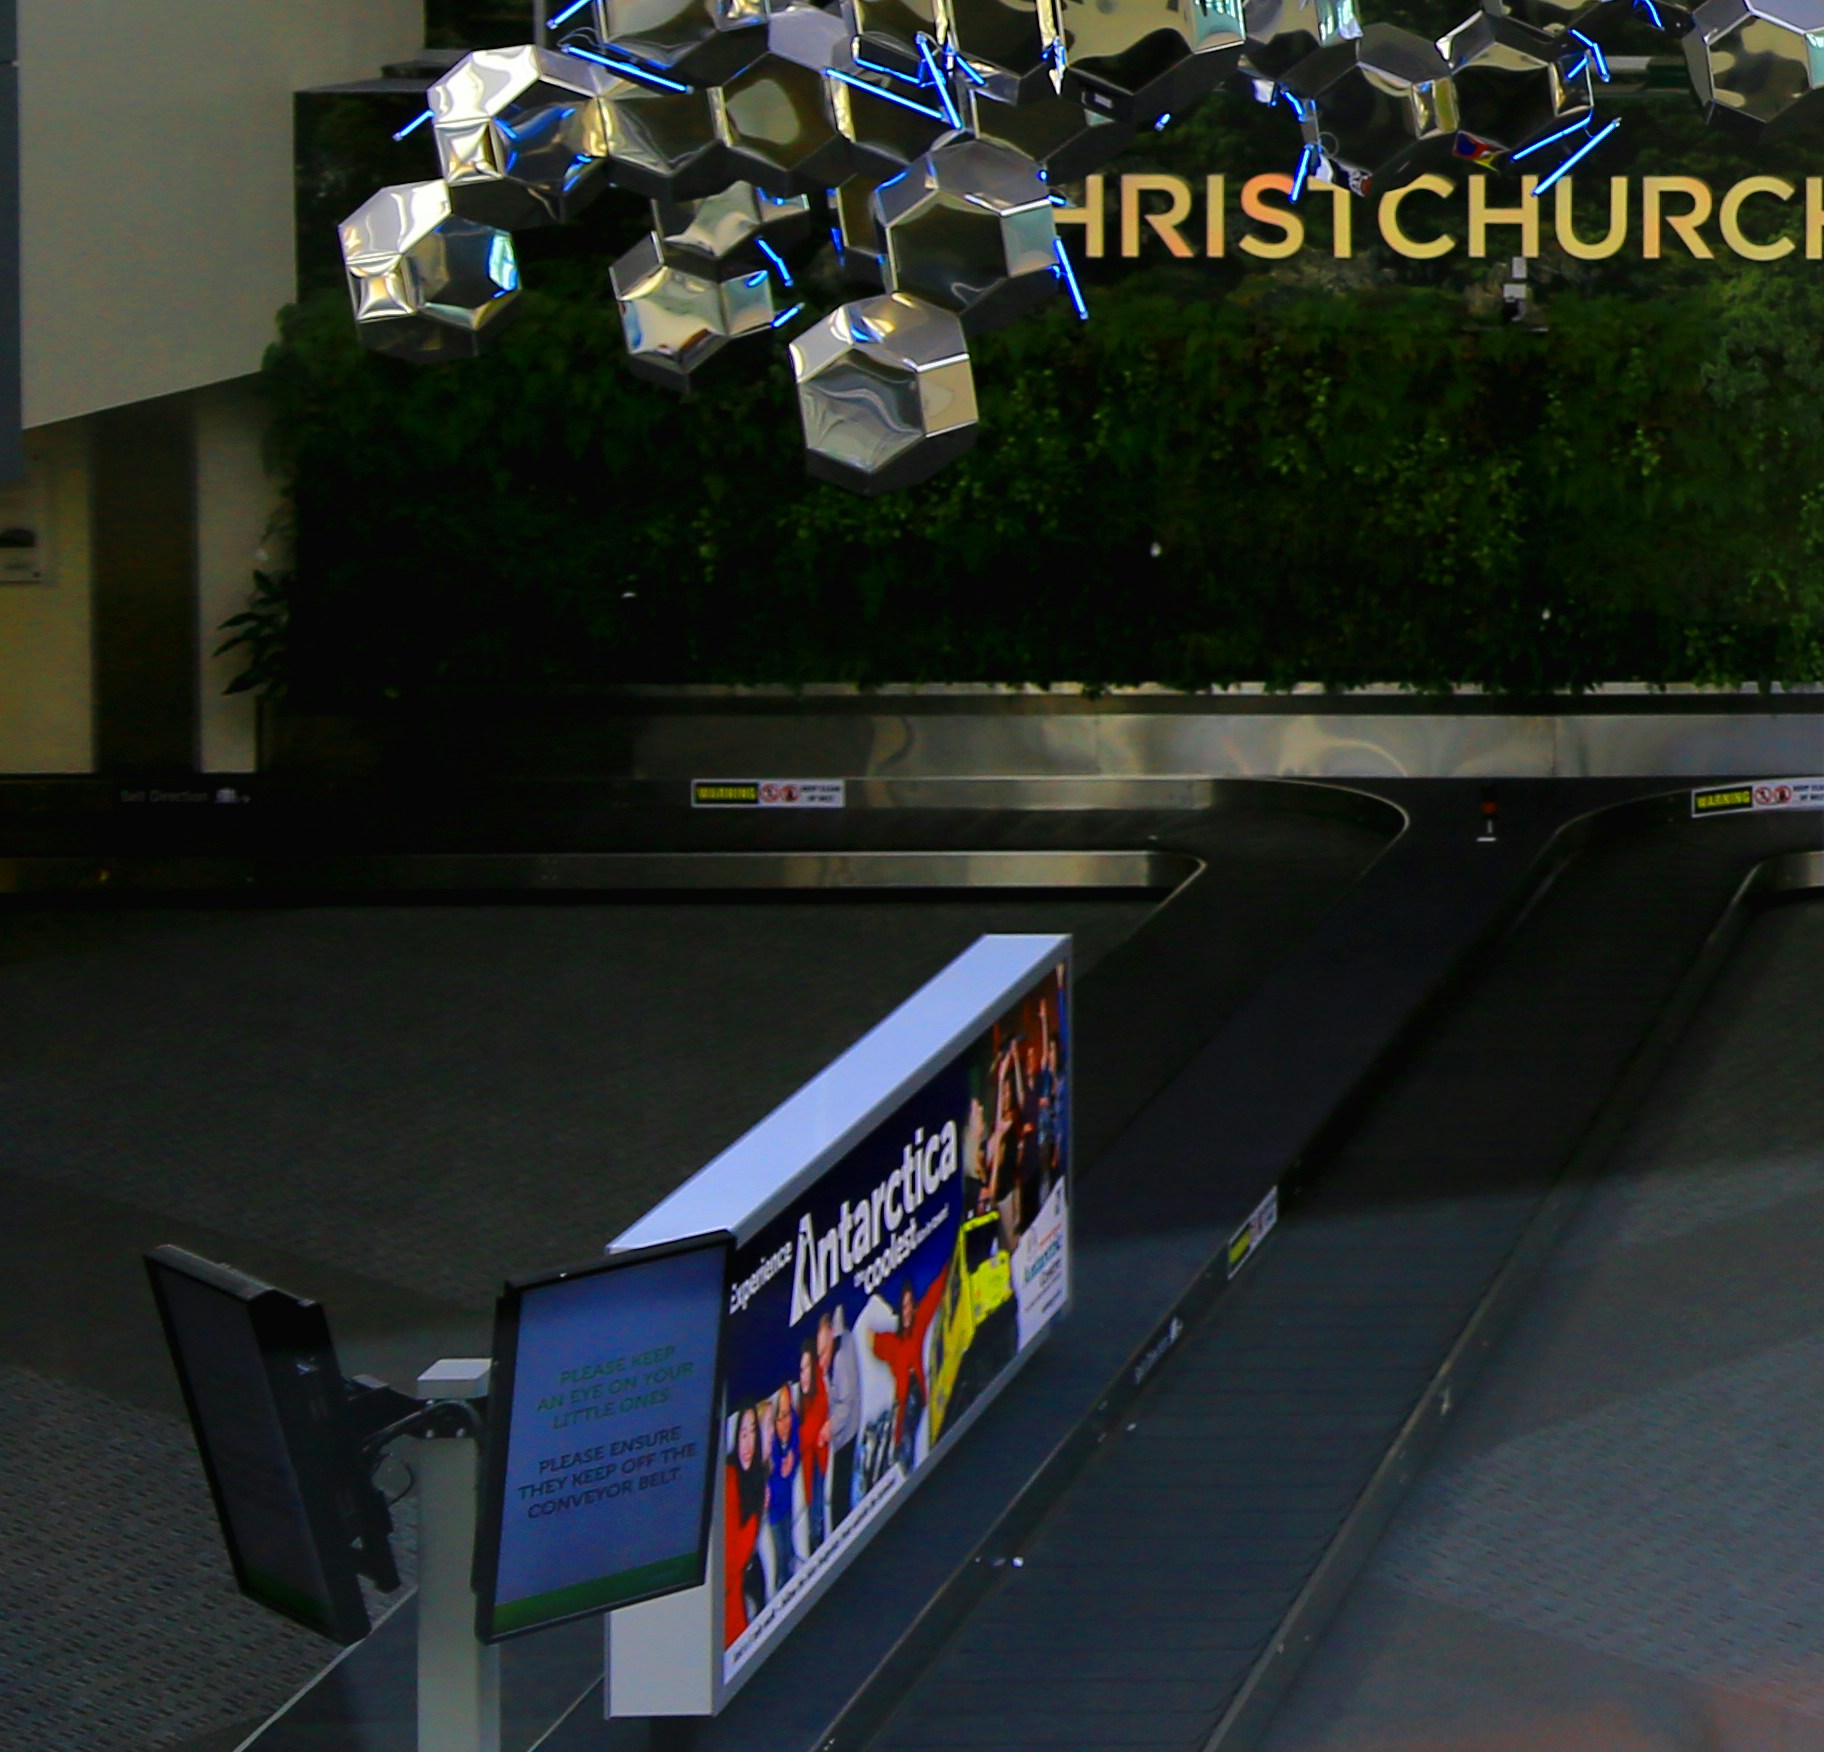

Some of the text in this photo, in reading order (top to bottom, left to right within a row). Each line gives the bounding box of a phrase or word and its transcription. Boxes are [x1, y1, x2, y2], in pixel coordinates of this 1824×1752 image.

[1696, 790, 1751, 809] WARNING
[728, 1119, 959, 1328] Experience Antarctica
[864, 1217, 917, 1295] coolest
[536, 1361, 695, 1412] AN EYE ON YOUR
[559, 1345, 676, 1385] PLEASE KEEP
[552, 1387, 672, 1430] LITTLE ONES
[517, 1442, 698, 1501] THEY KEEP OFF THE
[538, 1425, 682, 1475] PLEASE ENSURE
[527, 1467, 681, 1519] CONVEYOR BELT
